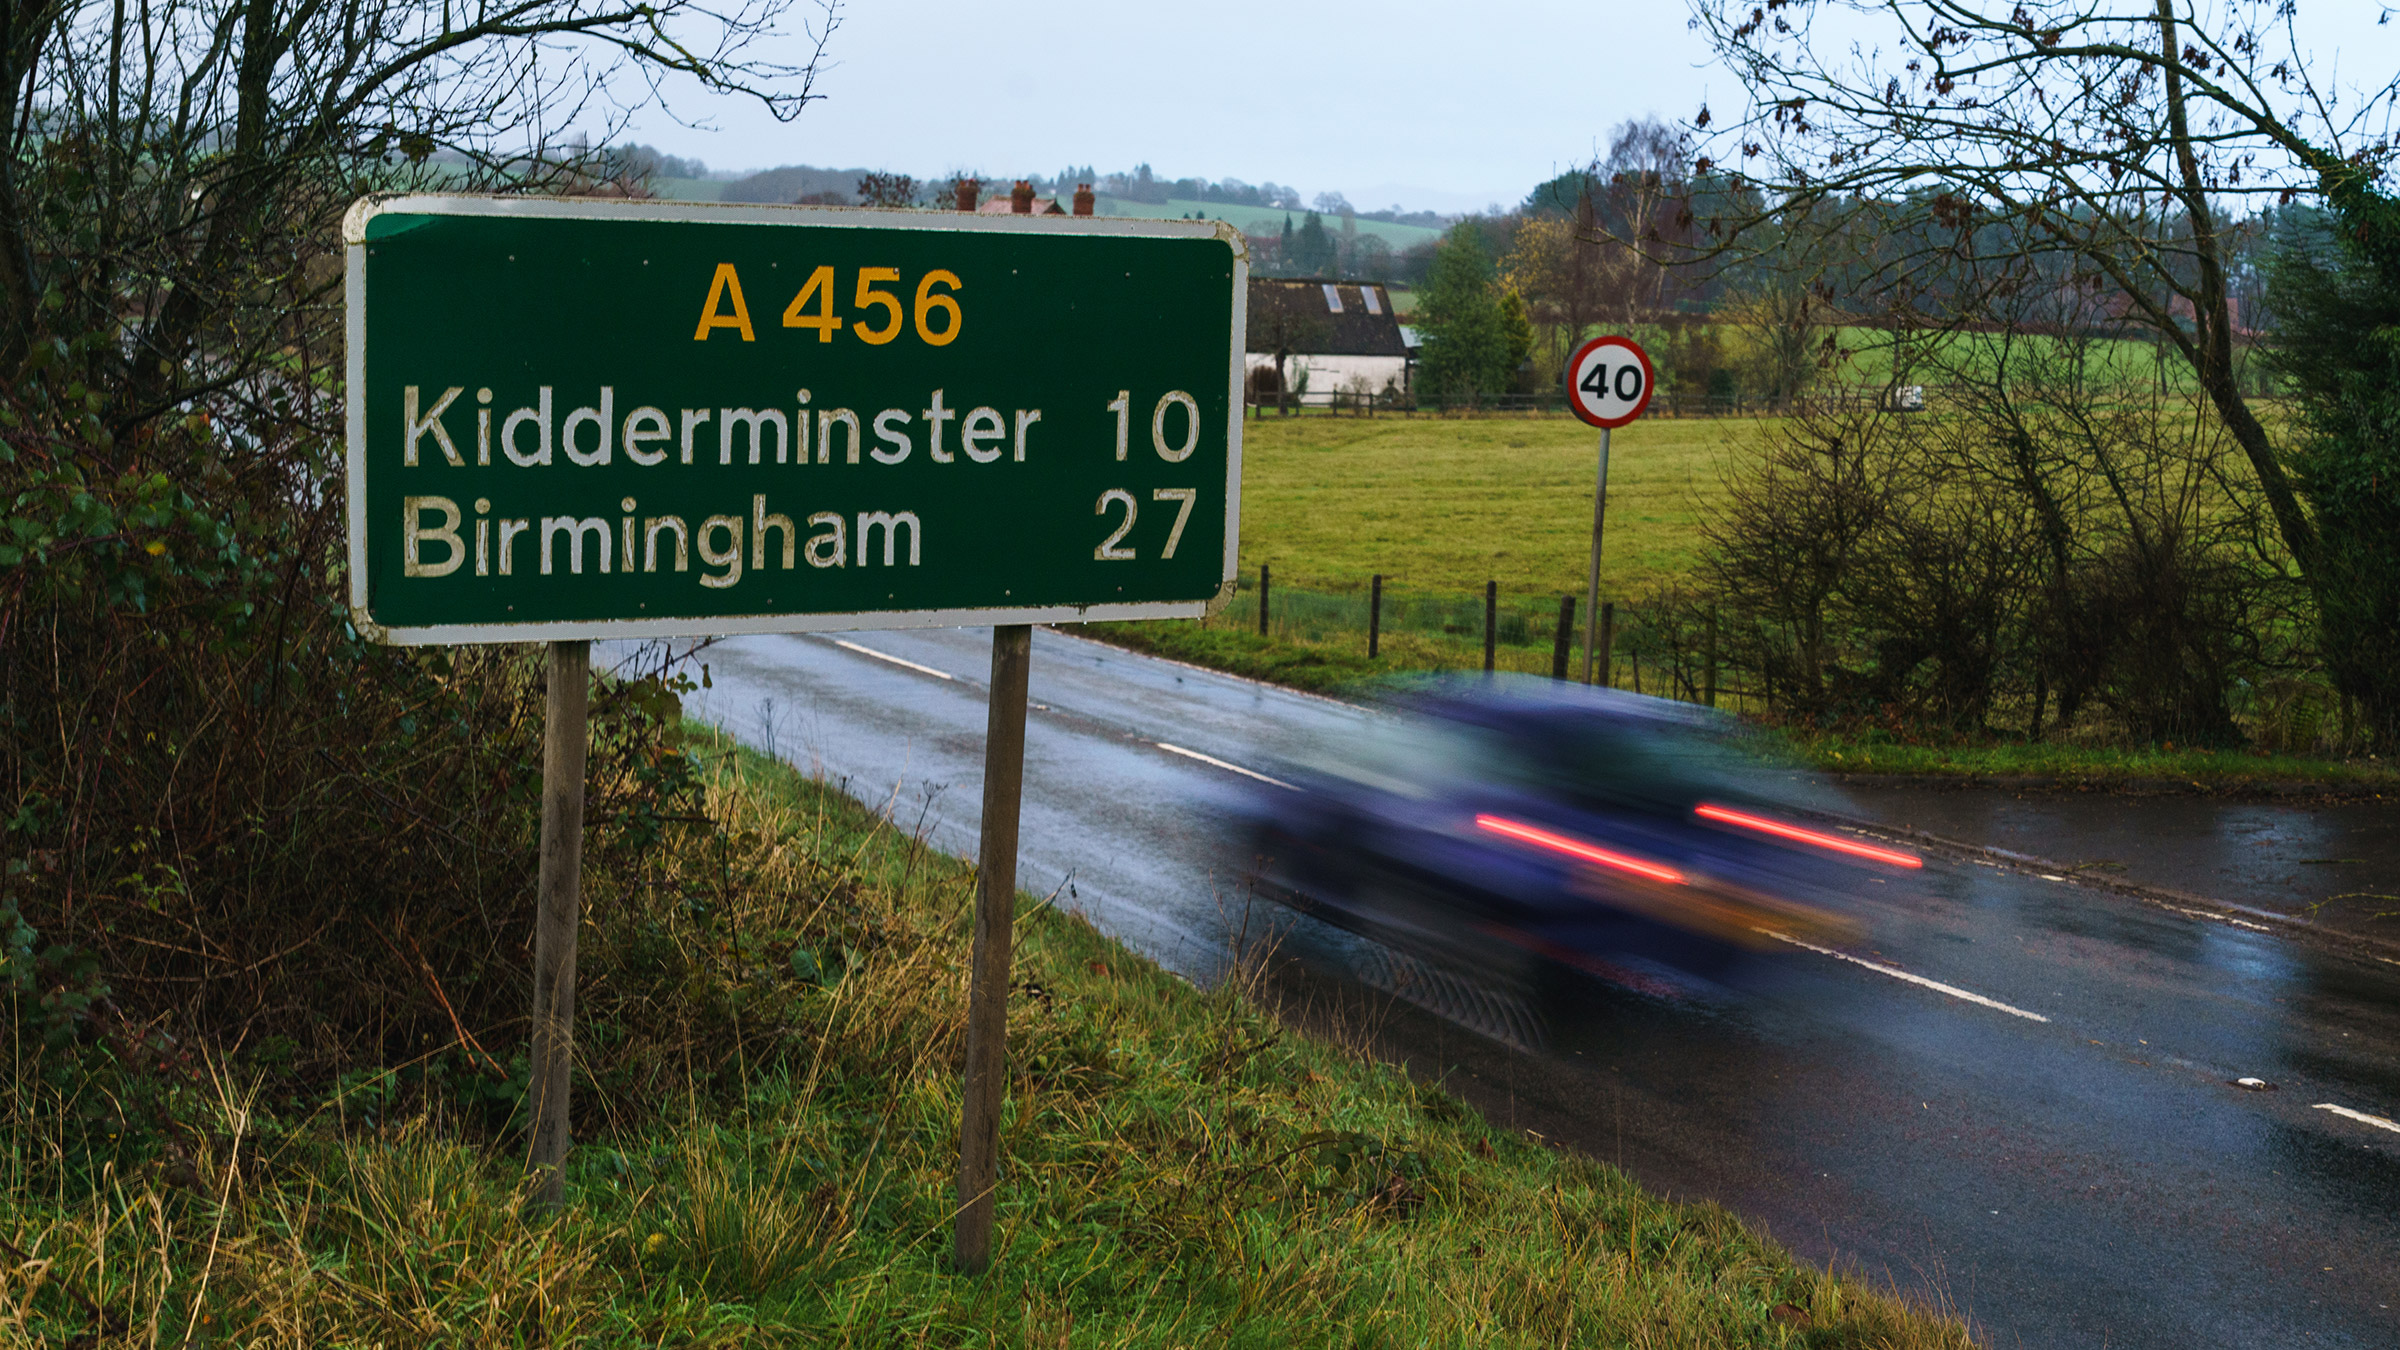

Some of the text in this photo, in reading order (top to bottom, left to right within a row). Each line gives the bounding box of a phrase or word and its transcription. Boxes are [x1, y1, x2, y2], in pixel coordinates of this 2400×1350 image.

[693, 262, 963, 347] A 456
[1579, 362, 1643, 403] 40
[404, 385, 1200, 468] Kidderminster 10
[403, 487, 1197, 588] Birmingham 27
